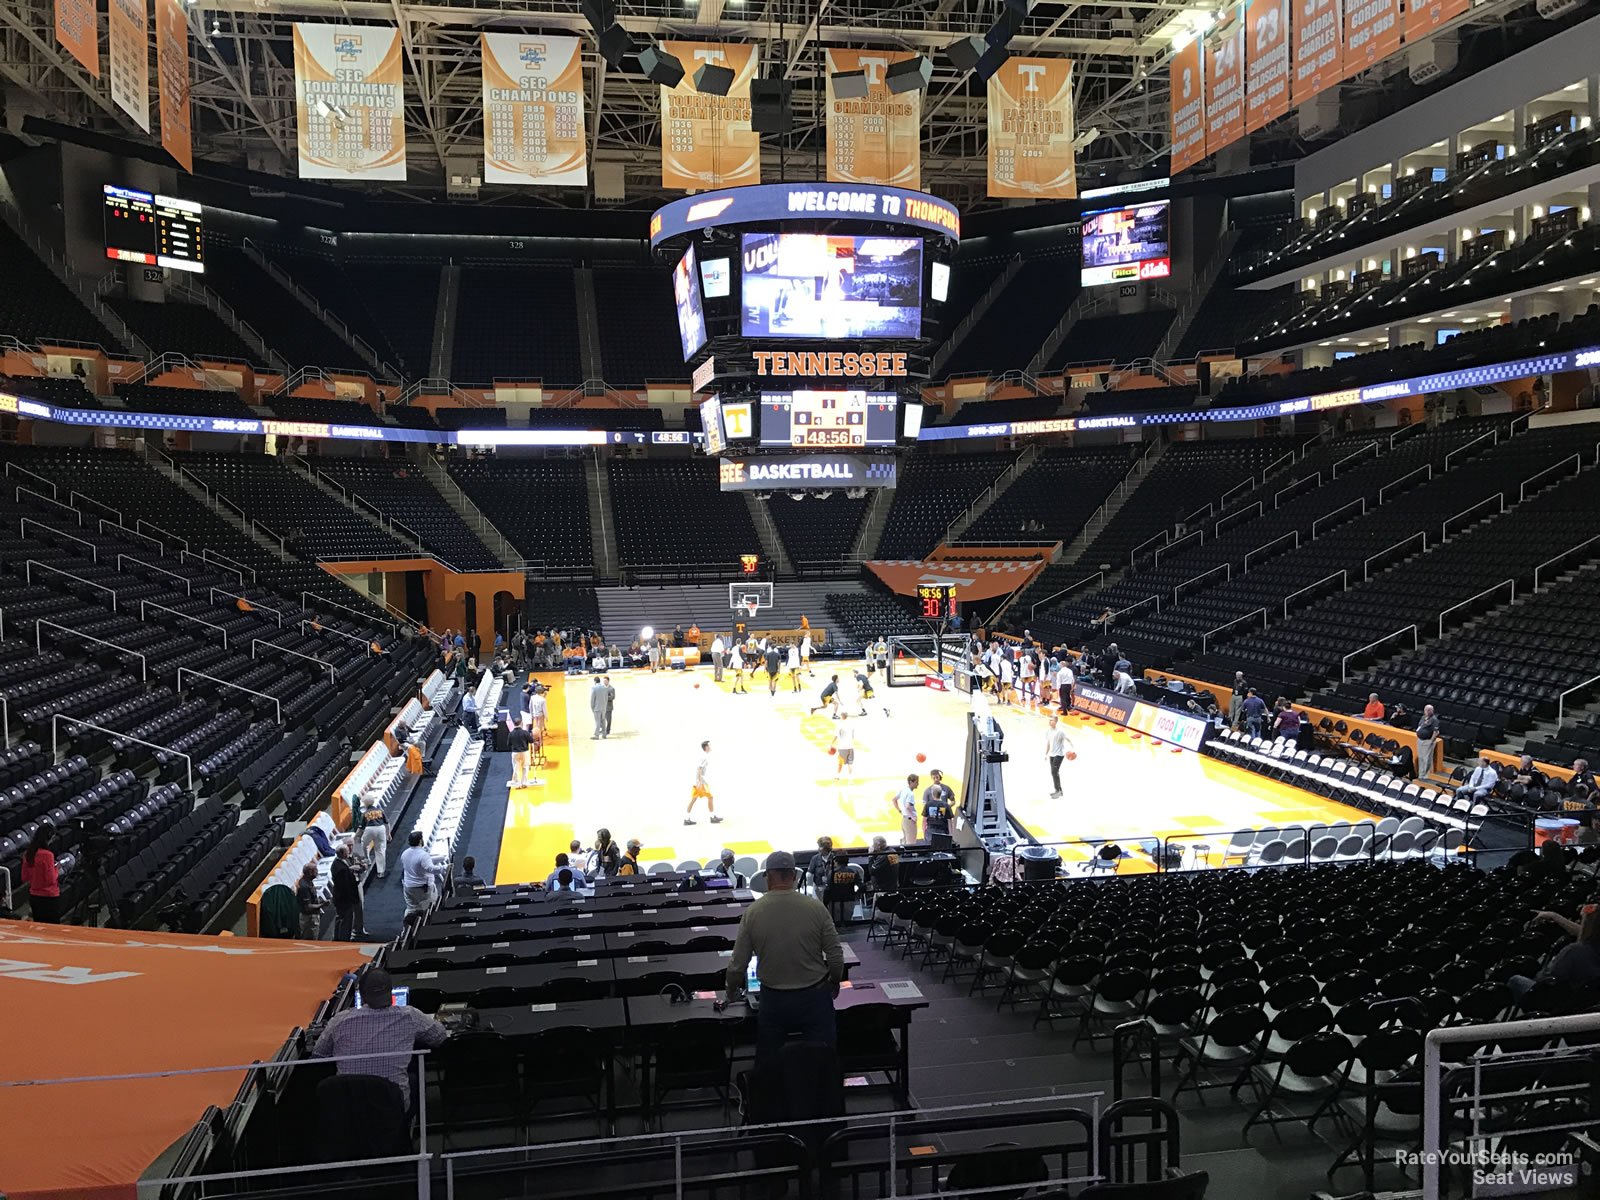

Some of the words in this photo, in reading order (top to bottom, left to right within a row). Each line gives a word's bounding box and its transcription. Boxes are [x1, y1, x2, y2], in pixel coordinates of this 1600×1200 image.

[1255, 6, 1280, 51] 23
[1300, 10, 1334, 43] DAEDRA
[1349, 12, 1395, 51] 1985-1989
[1298, 26, 1336, 61] CHARLES
[335, 69, 363, 82] SEC
[858, 56, 888, 85] T
[519, 76, 548, 90] SEC
[1018, 64, 1046, 92] T
[1182, 67, 1192, 99] 3
[304, 80, 396, 96] TOURNAMENT
[305, 92, 395, 108] CHAMPIONS
[490, 88, 578, 104] CHAMPIONS
[491, 103, 514, 112] 1980
[668, 95, 751, 110] TOURNAMENT
[1019, 97, 1046, 110] SEC
[555, 105, 578, 115] 2010
[669, 106, 752, 122] CHAMPIONS
[833, 101, 913, 117] CHAMPIONS
[491, 111, 514, 120] 1985
[522, 112, 546, 122] 2000
[555, 113, 578, 123] 2011
[863, 116, 885, 126] 2000
[1002, 108, 1062, 123] EASTERN
[369, 118, 393, 126] 2010
[492, 119, 514, 129] 1990
[522, 120, 546, 130] 2001
[1001, 120, 1064, 135] DIVISION
[369, 126, 392, 134] 2011
[492, 128, 514, 137] 1993
[522, 128, 547, 138] 2002
[671, 128, 693, 137] 1941
[833, 124, 856, 133] 1941
[308, 132, 332, 141] 1989
[337, 134, 363, 142] 2000
[369, 134, 392, 143] 2012
[492, 136, 515, 145] 1994
[522, 137, 548, 146] 2003
[671, 136, 693, 145] 1943
[1015, 132, 1051, 146] TITLE
[309, 141, 332, 150] 1992
[338, 142, 364, 151] 2005
[493, 144, 515, 154] 1995
[522, 145, 548, 155] 2004
[338, 150, 364, 159] 2006
[522, 154, 549, 163] 2007
[1022, 150, 1044, 159] 2009
[788, 191, 876, 213] WELCOME
[882, 195, 901, 216] TO
[509, 240, 524, 249] 328
[145, 270, 163, 281] 326
[1119, 287, 1136, 296] 300
[752, 351, 908, 377] TENNESSEE
[1311, 389, 1362, 410] TENNESSEE
[725, 408, 747, 433] T
[1010, 418, 1077, 435] TENNESSEE
[1078, 416, 1136, 430] BASKETBALL
[261, 420, 330, 437] TENNESSEE
[332, 426, 384, 439] BASKETBALL
[614, 433, 622, 443] 0
[808, 431, 848, 444] 48:56
[750, 463, 853, 480] BASKETBALL
[743, 562, 755, 572] 30
[919, 587, 942, 600] 48:56
[923, 598, 939, 617] 30
[736, 623, 746, 634] T
[1080, 688, 1106, 702] WELCOME
[1105, 694, 1114, 704] TO
[1107, 705, 1127, 722] ARENA
[1158, 716, 1174, 733] FOOD
[1183, 723, 1200, 739] CITY
[834, 872, 856, 880] EVENT
